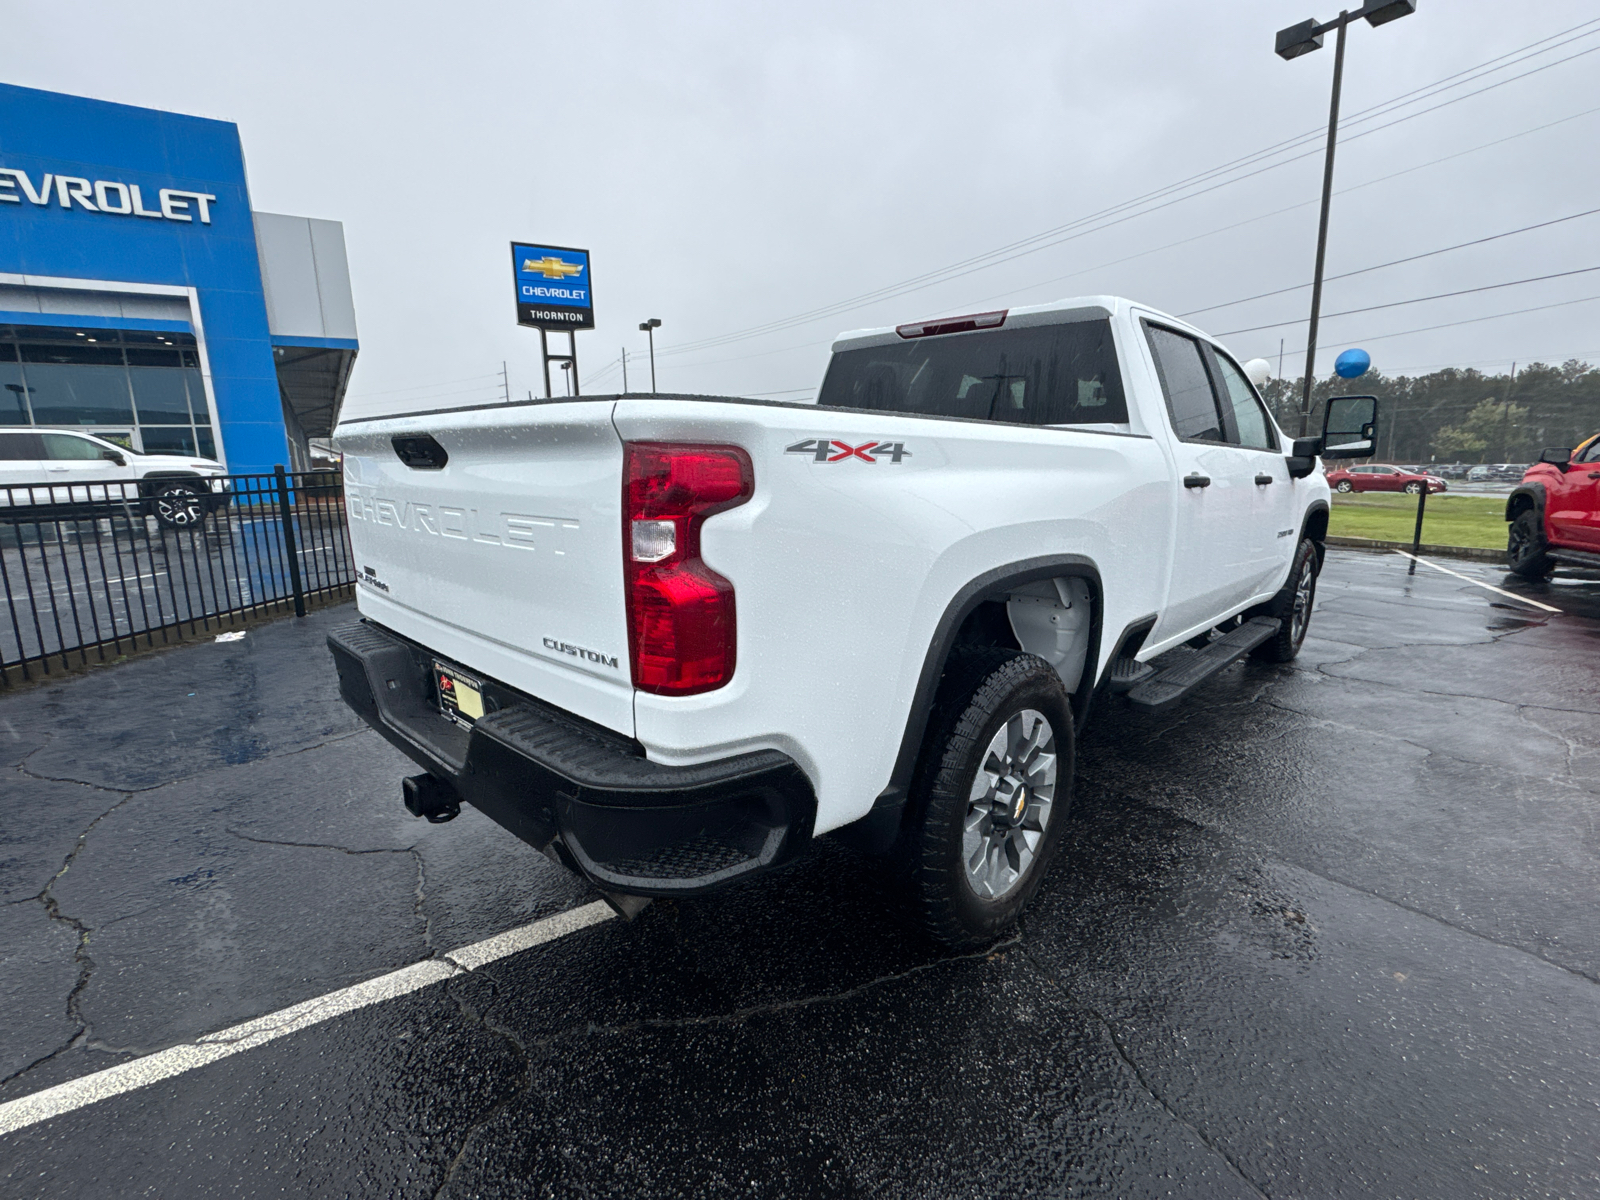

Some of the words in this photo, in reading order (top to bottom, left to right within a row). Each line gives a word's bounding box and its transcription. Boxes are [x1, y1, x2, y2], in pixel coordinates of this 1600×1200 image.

[522, 285, 586, 300] CHEVROLET
[530, 309, 584, 322] THORNTON
[349, 492, 580, 556] CHEVROLET
[542, 637, 619, 669] CUSTOM
